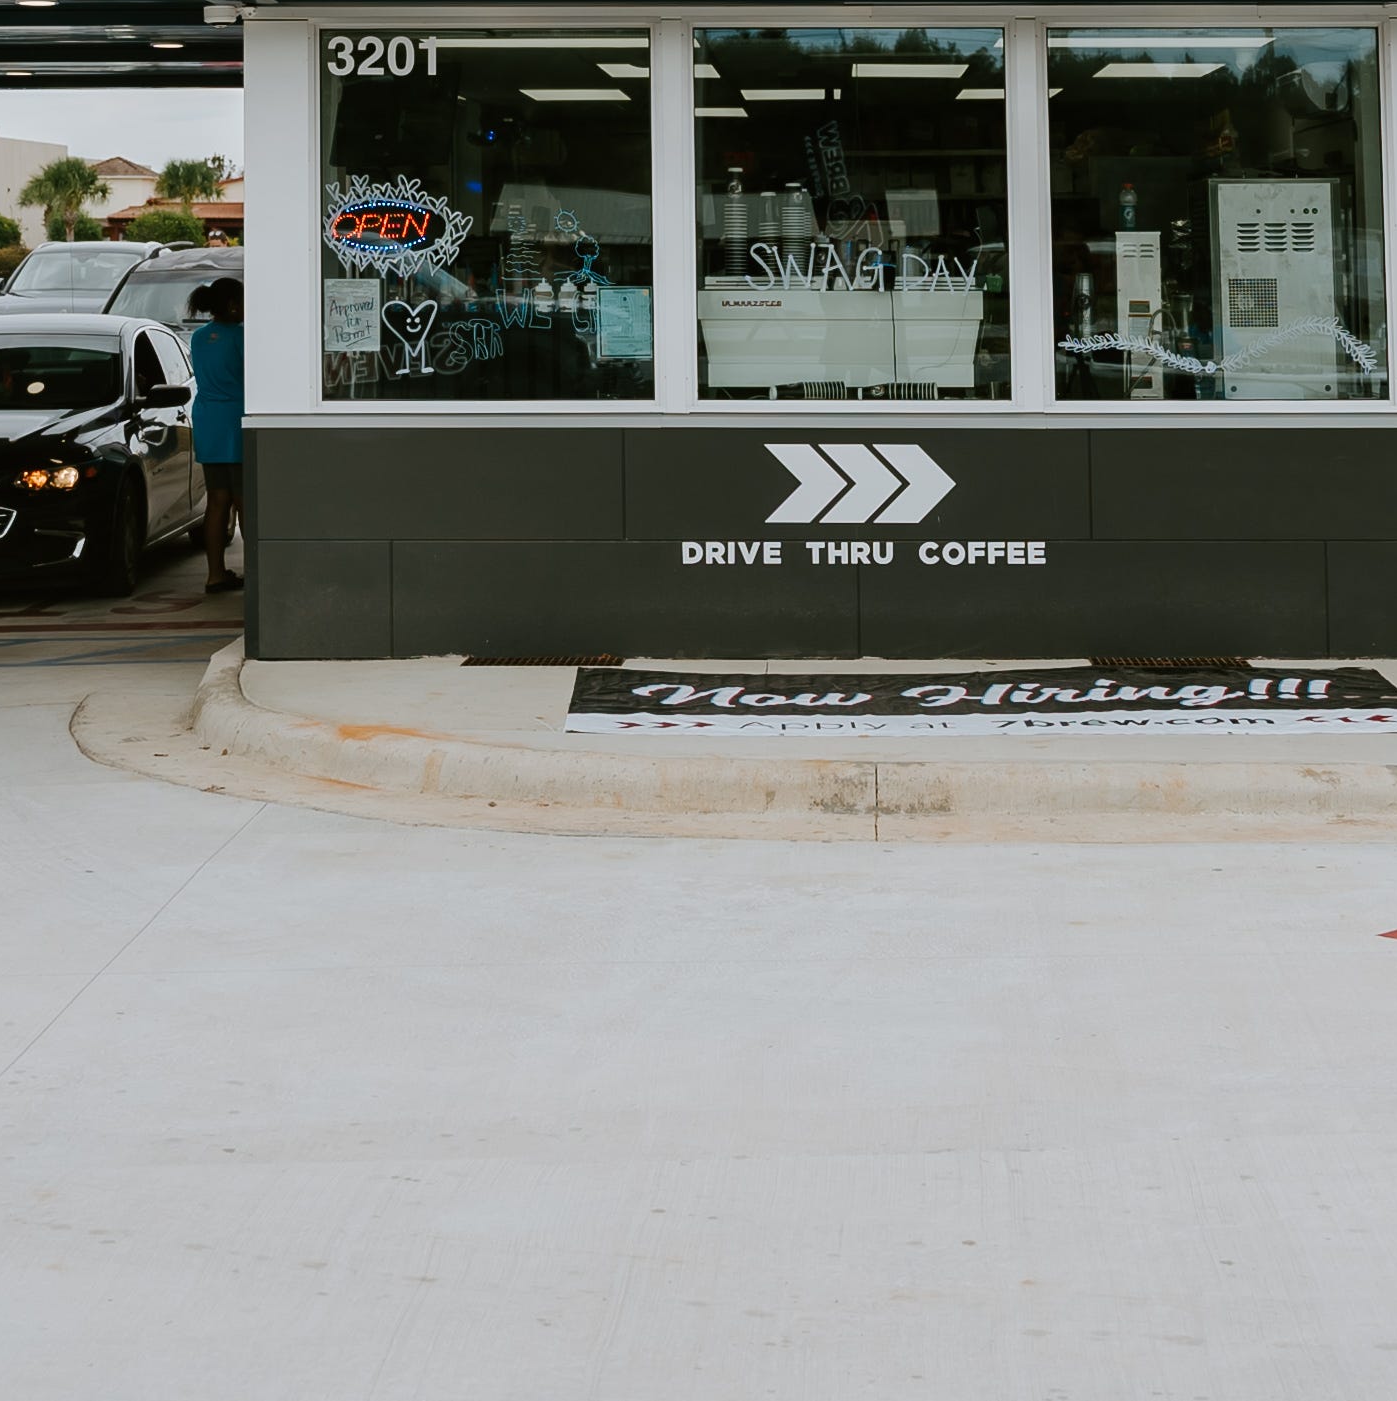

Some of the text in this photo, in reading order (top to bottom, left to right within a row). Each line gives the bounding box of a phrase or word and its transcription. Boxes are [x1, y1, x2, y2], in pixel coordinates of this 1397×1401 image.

[327, 35, 437, 76] 3201
[332, 212, 430, 239] OPEN
[745, 242, 978, 296] SWAG DAY
[329, 297, 375, 316] Approved
[681, 541, 1047, 566] DRIVE THRU COFFEE
[631, 683, 873, 708] Now
[739, 718, 1275, 731] Apply at 7brew.com
